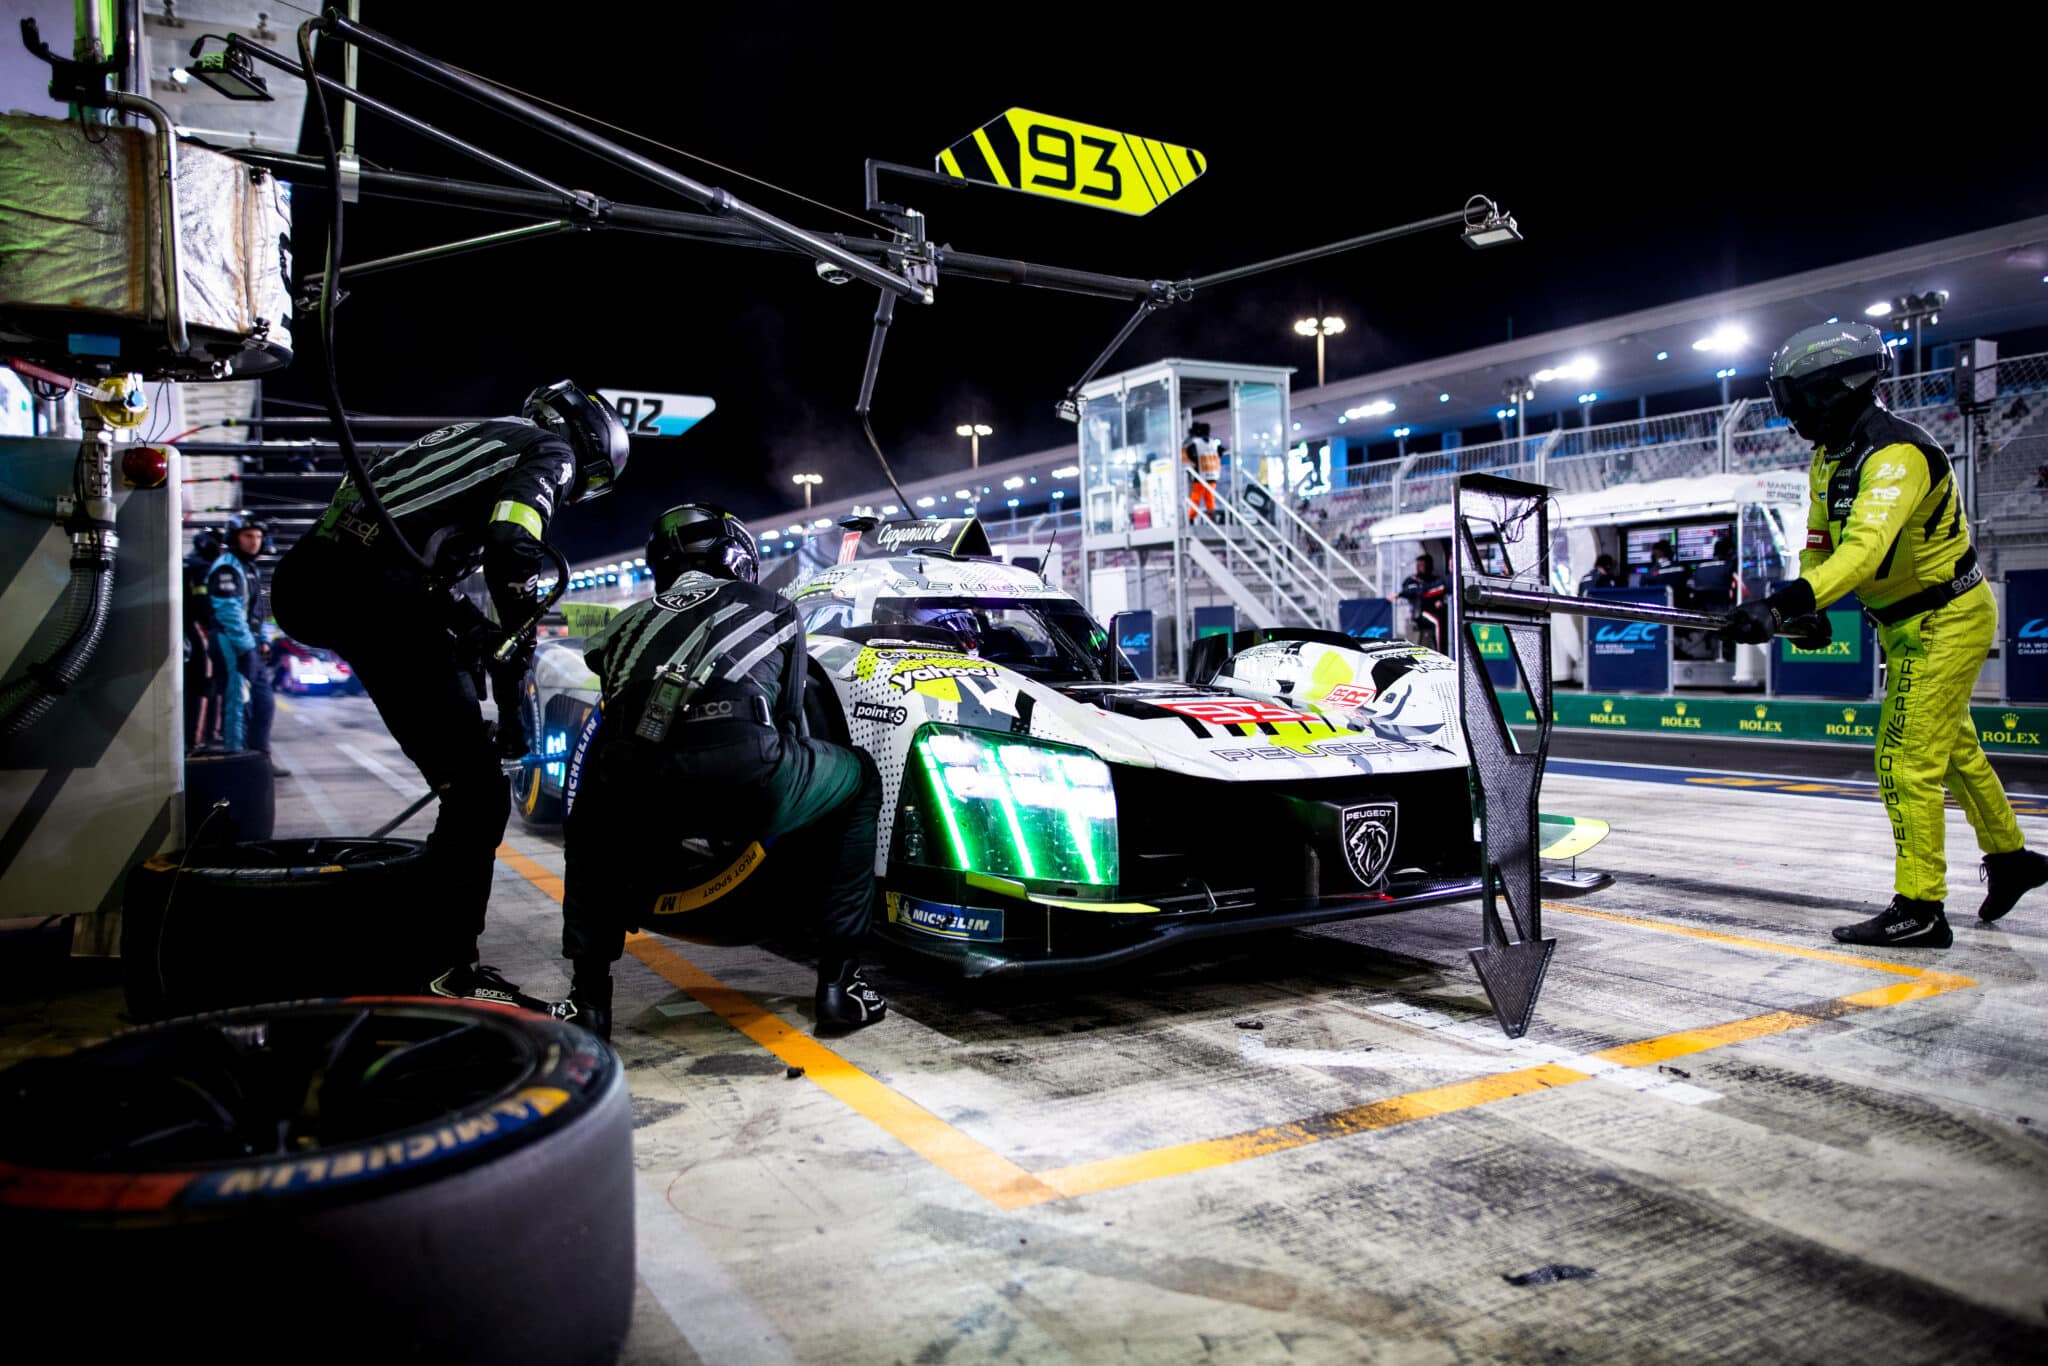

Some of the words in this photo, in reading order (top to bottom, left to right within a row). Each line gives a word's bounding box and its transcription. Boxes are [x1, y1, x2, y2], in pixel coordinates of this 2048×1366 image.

[1028, 124, 1122, 201] 93
[616, 397, 663, 432] 92
[877, 522, 938, 552] Capgemini
[1596, 622, 1659, 642] WEC
[889, 664, 999, 695] yahoo!
[1892, 643, 1918, 732] SPORT
[856, 705, 888, 720] point
[1172, 703, 1304, 722] 93
[1590, 713, 1626, 725] ROLEX
[1661, 715, 1701, 728] ROLEX
[1739, 719, 1782, 732] ROLEX
[1825, 723, 1874, 737] ROLEX
[1982, 731, 2040, 745] ROLEX
[1211, 740, 1434, 761] PEUGEOT
[567, 717, 598, 816] MICHELIN
[1879, 740, 1908, 858] PEUGEOT
[1346, 810, 1392, 821] PEUGEOT
[734, 850, 757, 877] PILOT
[703, 874, 733, 898] SPORT
[475, 988, 512, 1000] sparco
[217, 1112, 500, 1196] MICHELIN
